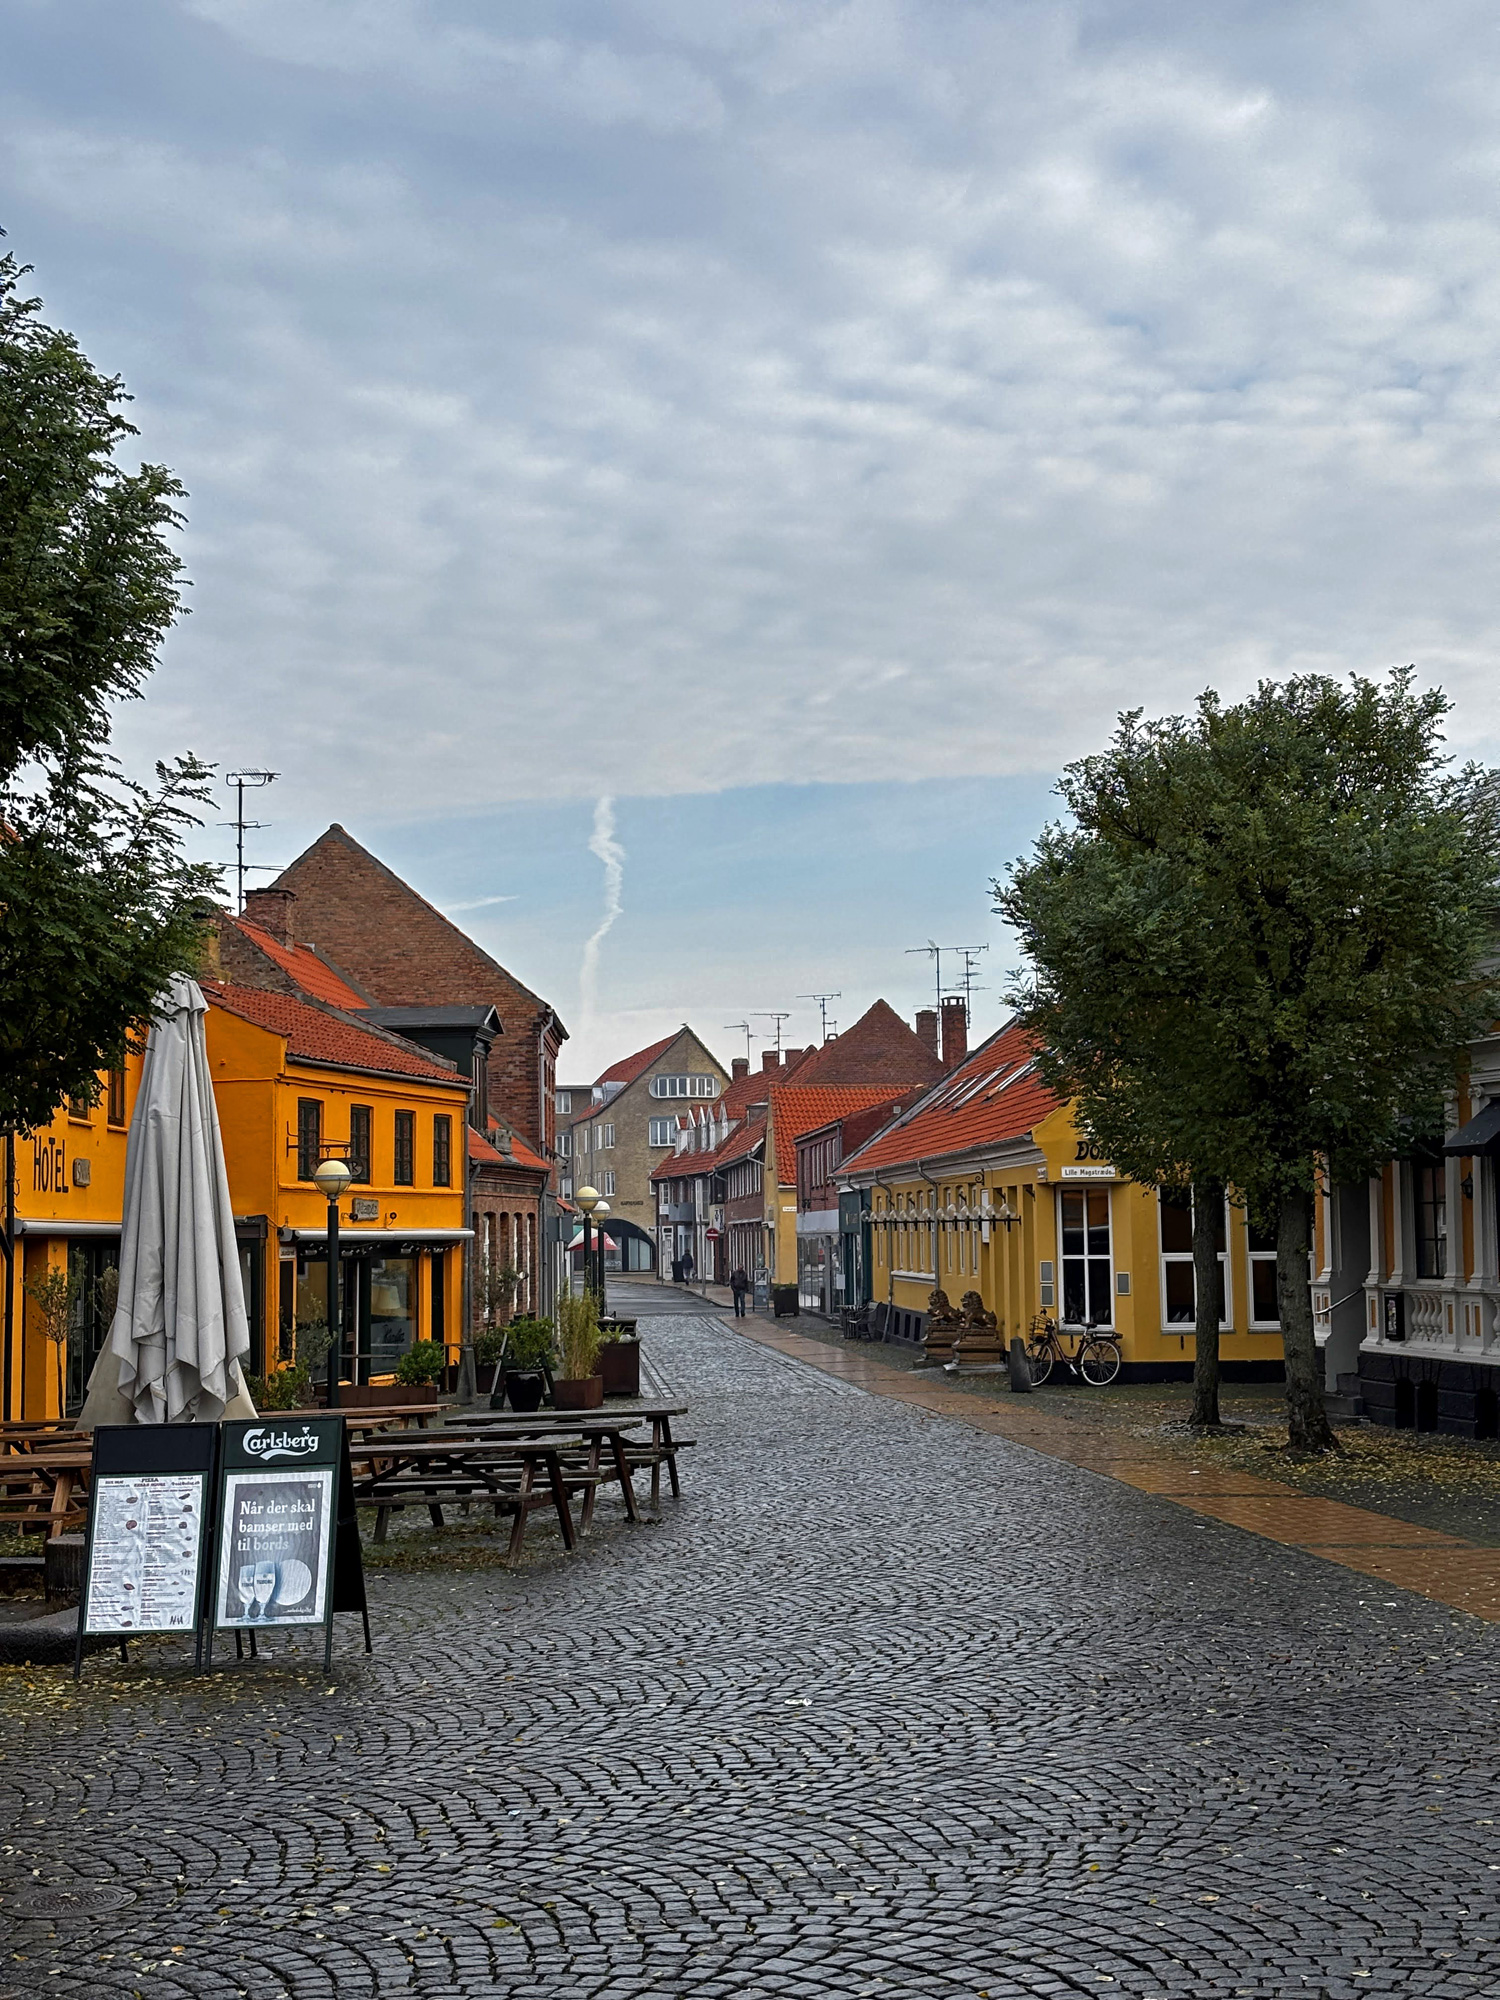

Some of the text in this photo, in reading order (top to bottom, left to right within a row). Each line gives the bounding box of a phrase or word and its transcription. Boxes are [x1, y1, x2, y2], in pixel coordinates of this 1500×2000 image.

[33, 1135, 69, 1193] HOTEL
[1064, 1168, 1078, 1176] Lille
[242, 1427, 319, 1458] Carlsberg
[240, 1498, 315, 1515] Når der skal
[239, 1516, 313, 1533] bamser med
[237, 1536, 289, 1552] til bords
